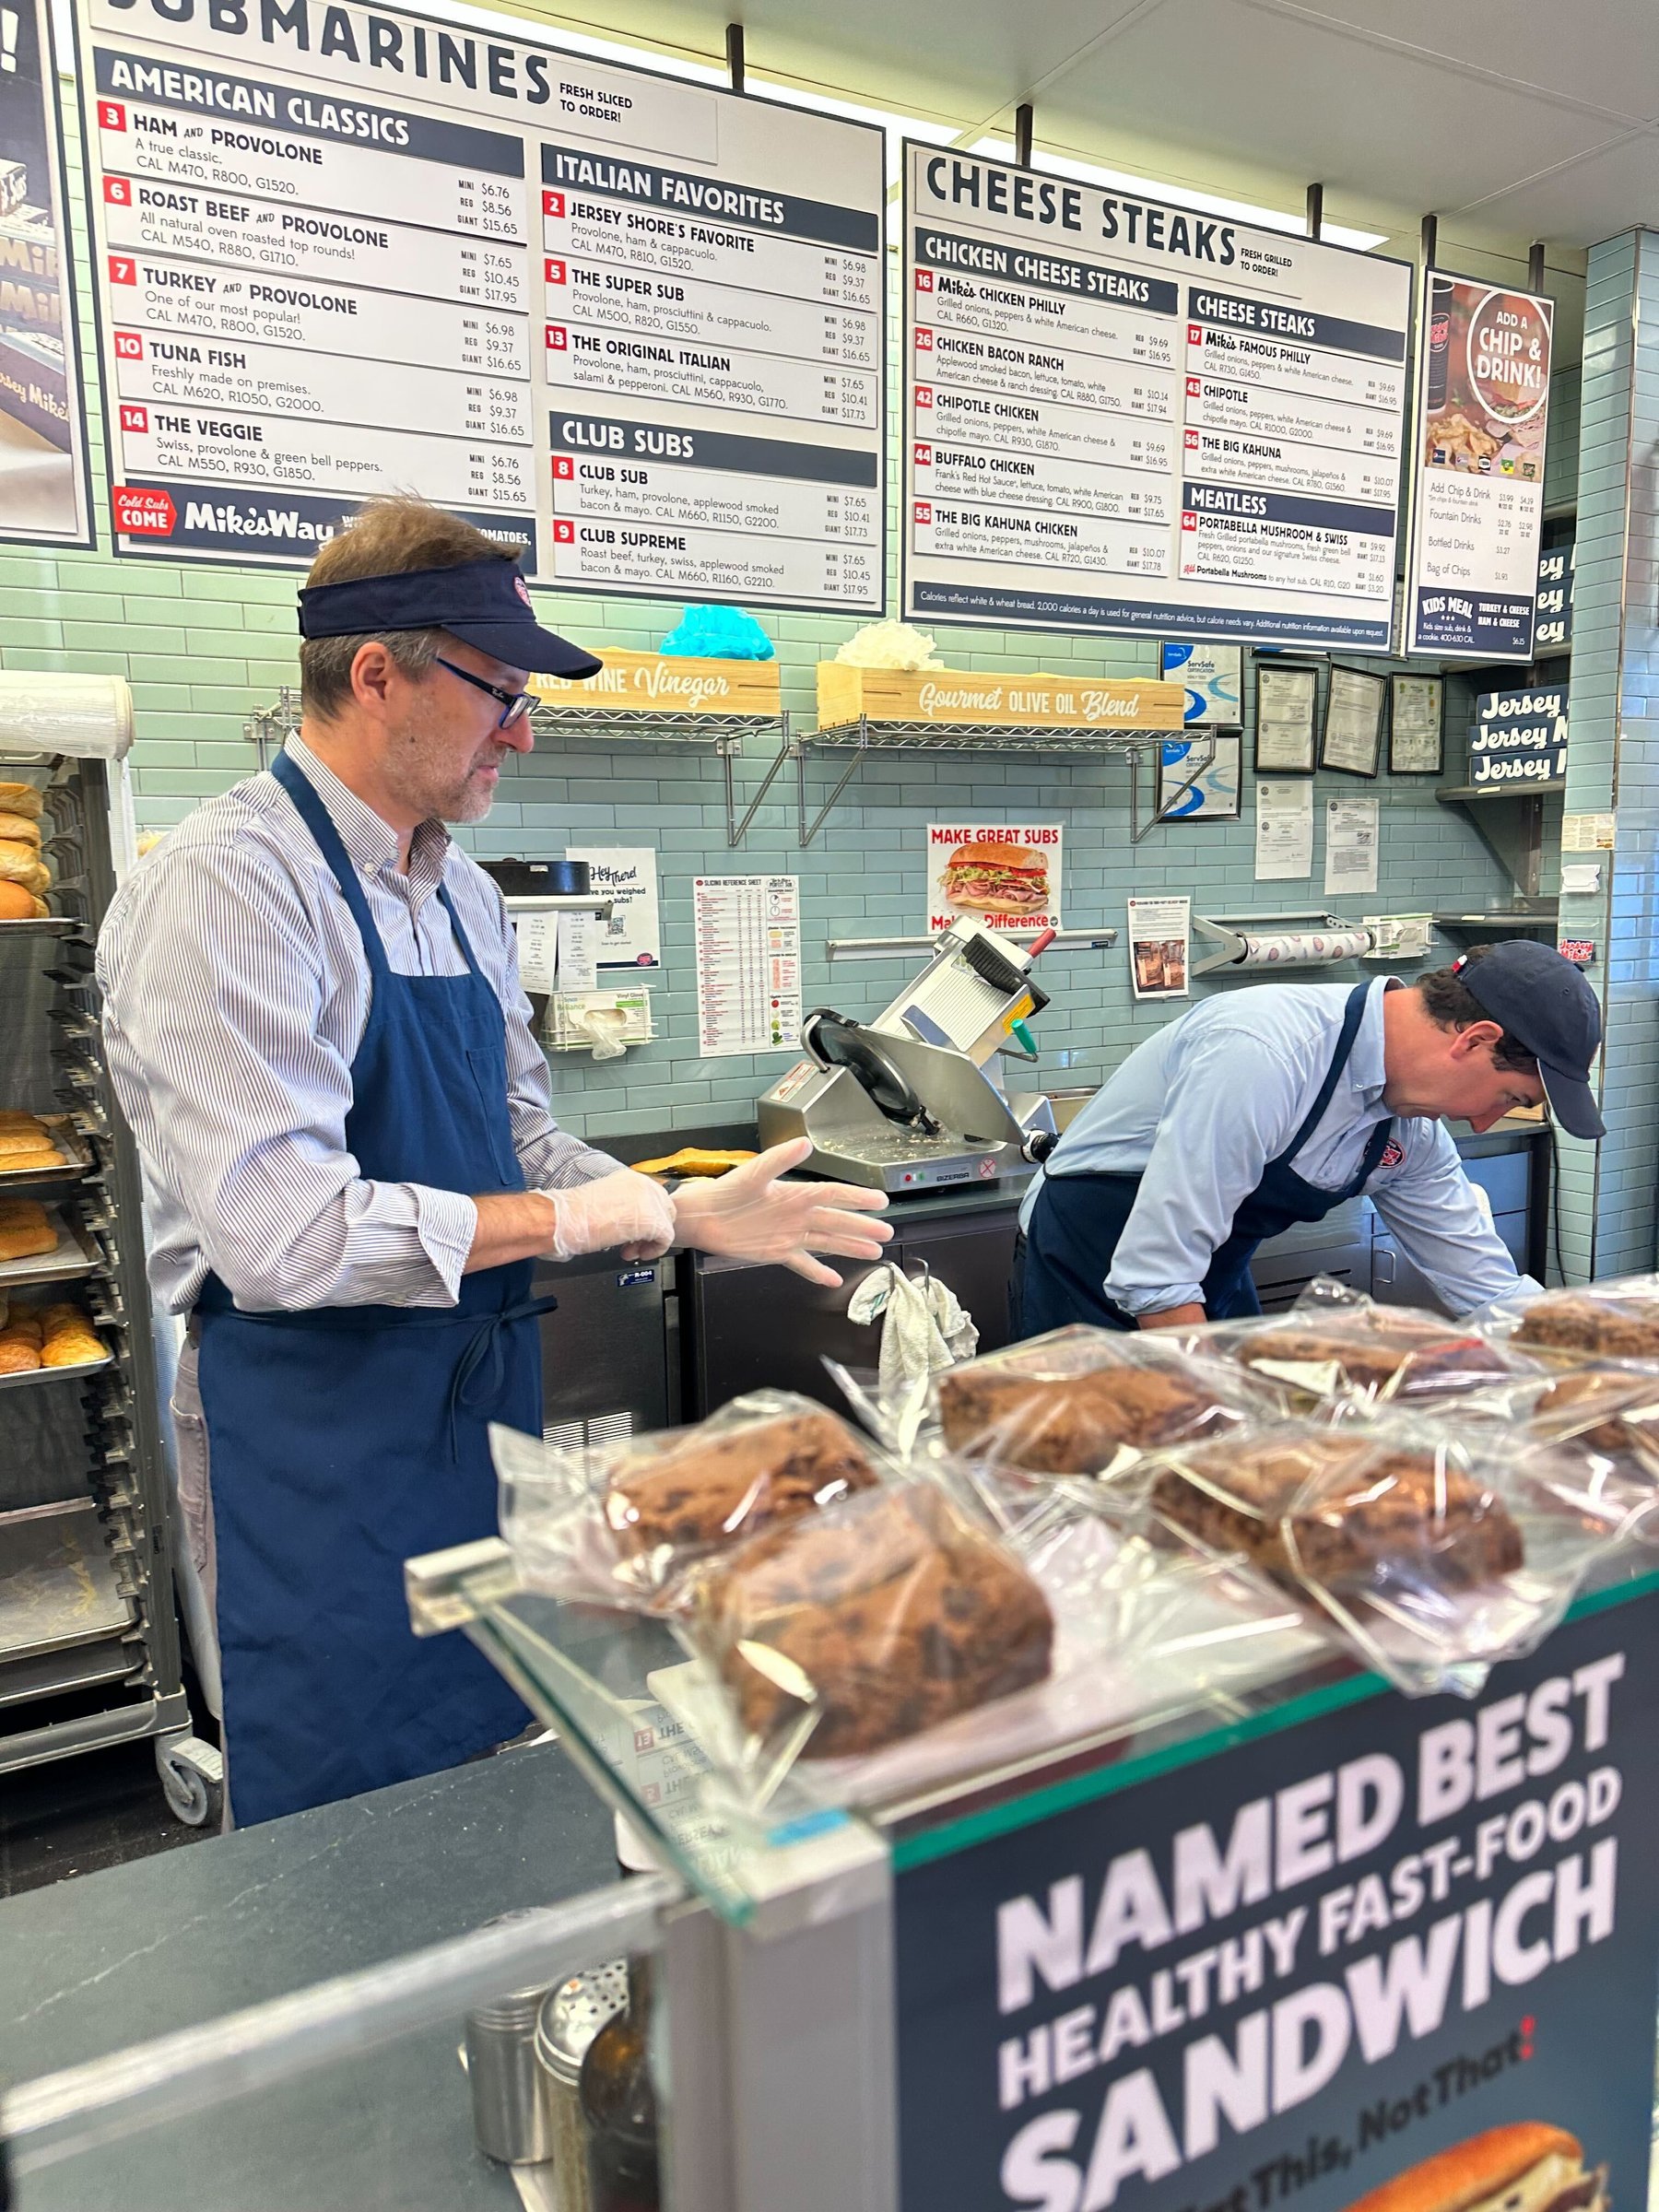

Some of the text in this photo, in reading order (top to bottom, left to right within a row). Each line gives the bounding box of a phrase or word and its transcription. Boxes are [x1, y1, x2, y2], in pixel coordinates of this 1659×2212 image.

[104, 0, 551, 104] BMARINES
[112, 60, 409, 145] AMERICAN CLASSICS
[559, 82, 632, 109] FRESH SLICED
[106, 108, 119, 125] 3
[559, 99, 620, 123] TO ORDER!
[134, 113, 323, 165] HAM AND PROVOLONE
[135, 137, 222, 164] A true classic.
[136, 155, 299, 195] CAL M470, R800, G1520.
[111, 183, 124, 200] 6
[481, 182, 510, 199] $6.76
[557, 154, 784, 224] ITALIAN FAVORITES
[549, 197, 559, 212] 2
[927, 157, 1235, 265] CHEESE STEAKS
[139, 188, 388, 250] ROAST BEEF AND PROVOLONE
[457, 215, 518, 234] GIANT $15.65
[571, 202, 754, 254] JERSEY SHORE'S FAVORITE
[140, 211, 355, 260] All natural oven roasted top rounds!
[918, 275, 931, 288] 16
[925, 237, 1148, 302] CHICKEN CHEESE STEAKS
[143, 267, 358, 315] TURKEY AND PROVOLONE
[842, 289, 870, 304] $16.65
[938, 276, 1065, 315] Mike's CHICKEN PHILLY
[1197, 295, 1314, 336] CHEESE STEAKS
[1496, 312, 1527, 329] ADD A
[571, 335, 730, 371] THE ORIGINAL ITALIAN
[916, 333, 932, 347] 26
[1479, 327, 1523, 356] CHIP
[1529, 338, 1541, 361] &
[149, 342, 246, 369] TUNA FISH
[936, 337, 1064, 371] CHICKEN BACON RANCH
[1477, 354, 1541, 388] DRINK!
[936, 394, 1039, 421] CHIPOTLE CHICKEN
[154, 415, 263, 441] THE VEGGIE
[562, 420, 694, 458] CLUB SUBS
[580, 465, 648, 485] CLUB SUB
[935, 452, 1034, 476] BUFFALO CHICKEN
[118, 495, 169, 511] Cold Subs
[579, 483, 779, 514] Turkey, ham, provolone, applewood smoked
[1191, 488, 1266, 515] MEATLESS
[1431, 482, 1491, 500] Add Chip & Drink
[122, 510, 168, 529] COME
[184, 501, 272, 536] Mike's
[844, 525, 867, 537] $17.73
[935, 510, 1077, 537] THE BIG KAHUNA CHICKEN
[1199, 516, 1347, 546] PORTABELLA MUSHROOM & SWISS
[476, 528, 532, 546] OMATOES.
[580, 528, 686, 550] CLUB SUPREME
[1196, 565, 1267, 581] Portabella Mushrooms
[921, 591, 969, 604] Calories reflect
[1422, 596, 1474, 618] KIDS MEAL
[1478, 603, 1530, 616] TURKEY & CHEESE
[1187, 660, 1215, 668] ServSafe
[634, 662, 729, 708] Vinegar
[920, 682, 1140, 722] Gourmet OLIVE OIL Blend
[1482, 692, 1560, 719] Jersey
[1472, 724, 1547, 750] Jersey
[1475, 756, 1550, 781] Jersey
[932, 830, 1058, 844] MAKE GREAT SUBS
[589, 865, 610, 881] Hey
[983, 914, 1049, 930] Difference
[1559, 939, 1594, 953] Jersey
[935, 1172, 970, 1182] BIZERBA
[997, 1653, 1625, 2014] NAMED BEST
[998, 1766, 1622, 2111] HEALTHY FAST-FOOD
[1001, 1837, 1618, 2212] SANDWICH
[1252, 2135, 1355, 2207] This,
[1357, 2081, 1432, 2154] Not
[1432, 2014, 1536, 2107] That!
